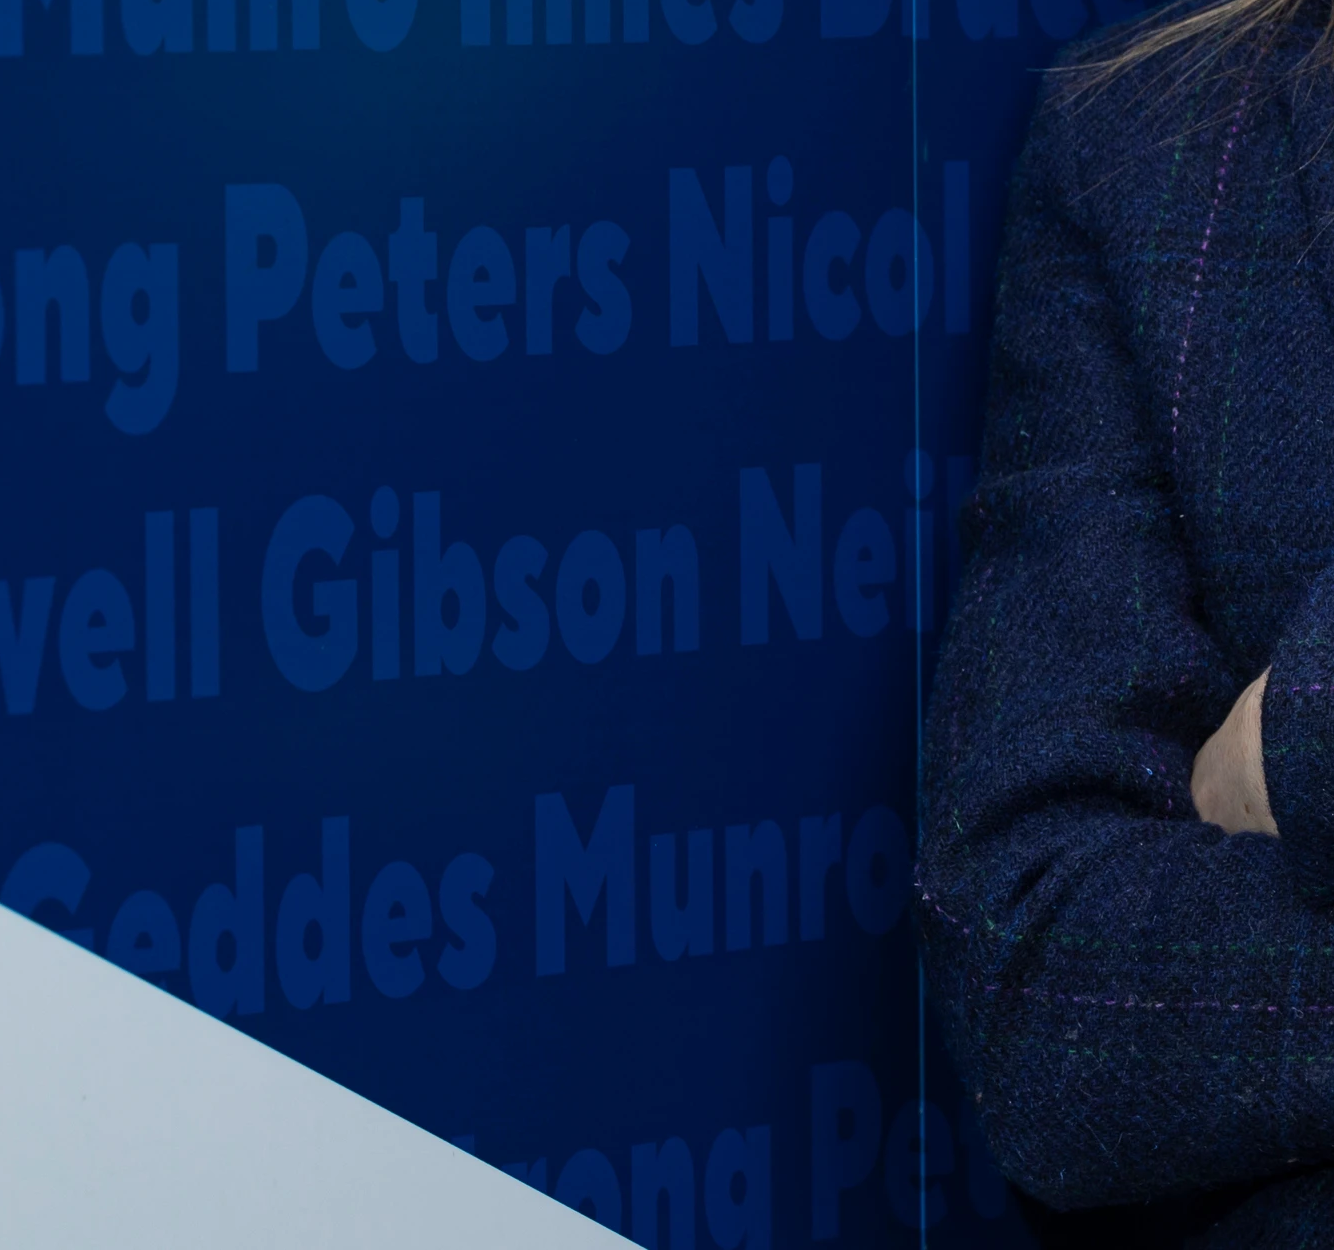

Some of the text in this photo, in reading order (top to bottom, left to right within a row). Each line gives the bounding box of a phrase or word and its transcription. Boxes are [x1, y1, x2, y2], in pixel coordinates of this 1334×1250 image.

[225, 182, 634, 370] Peters
[669, 154, 970, 347] Nicol
[261, 483, 702, 692] Gibson
[533, 782, 910, 978] Munro
